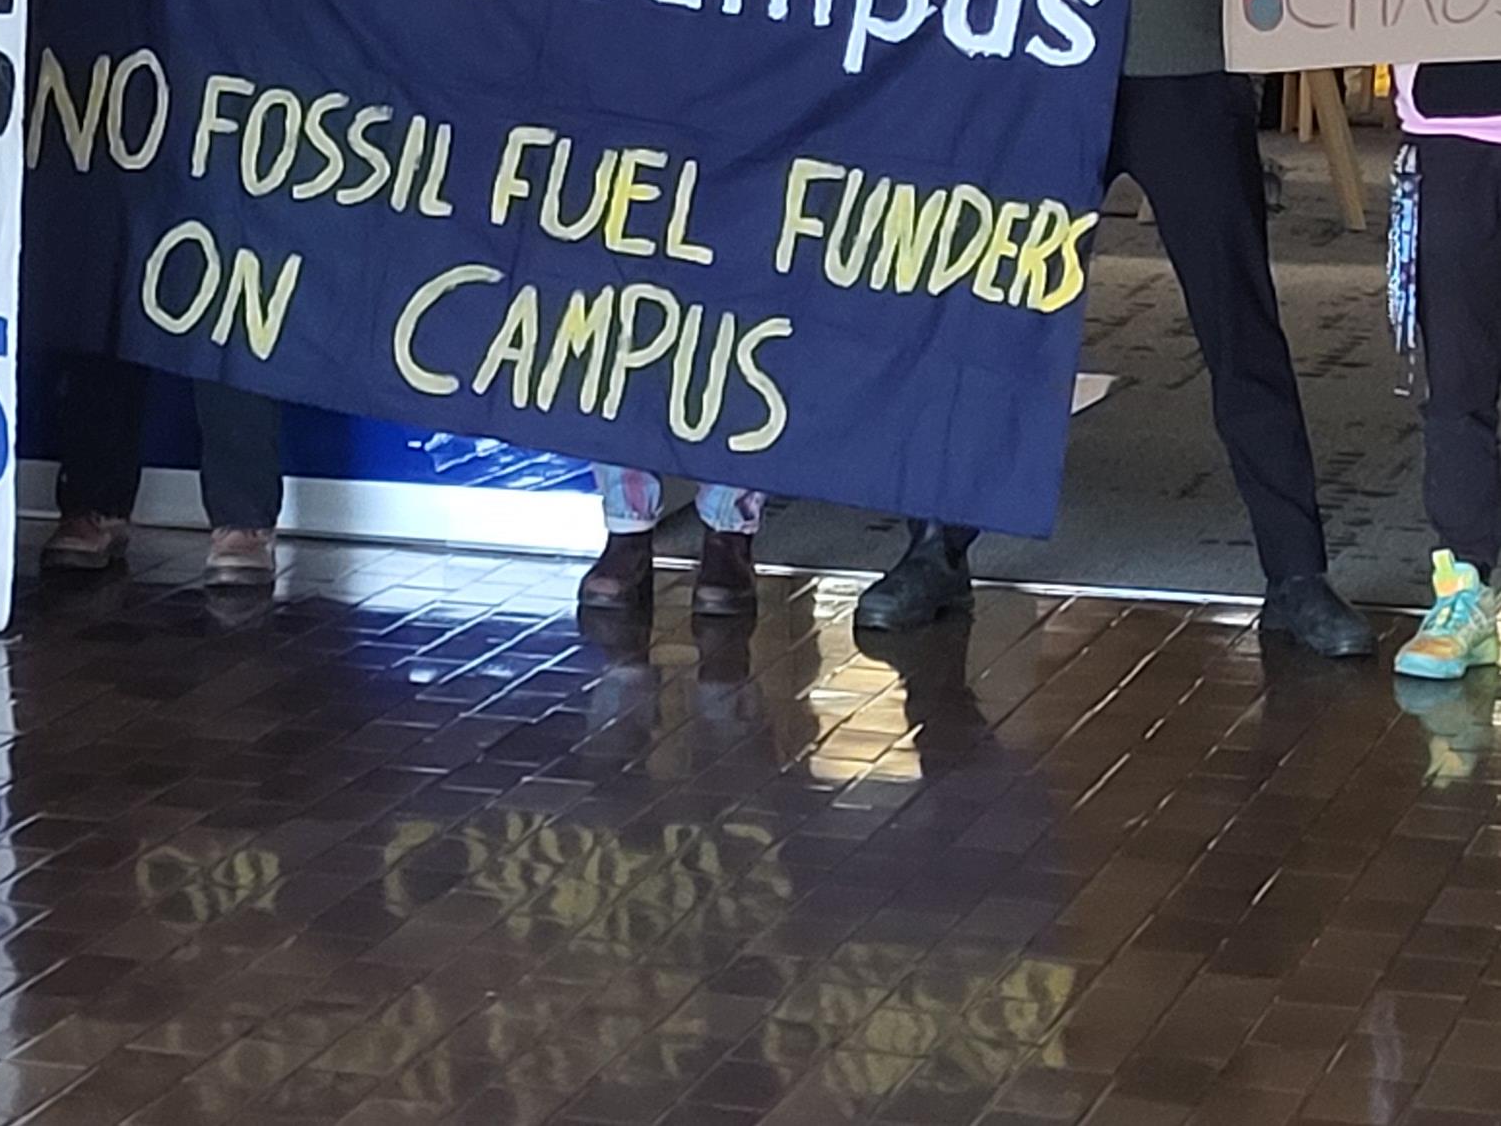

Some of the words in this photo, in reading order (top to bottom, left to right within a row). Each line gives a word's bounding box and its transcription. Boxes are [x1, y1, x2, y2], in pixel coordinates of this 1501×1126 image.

[27, 46, 171, 172] NO
[190, 74, 454, 218] FOSSIL
[490, 125, 714, 266] FUEL
[775, 157, 1100, 314] FUNDERS
[141, 219, 303, 362] ON
[393, 264, 795, 455] CAMPUS
